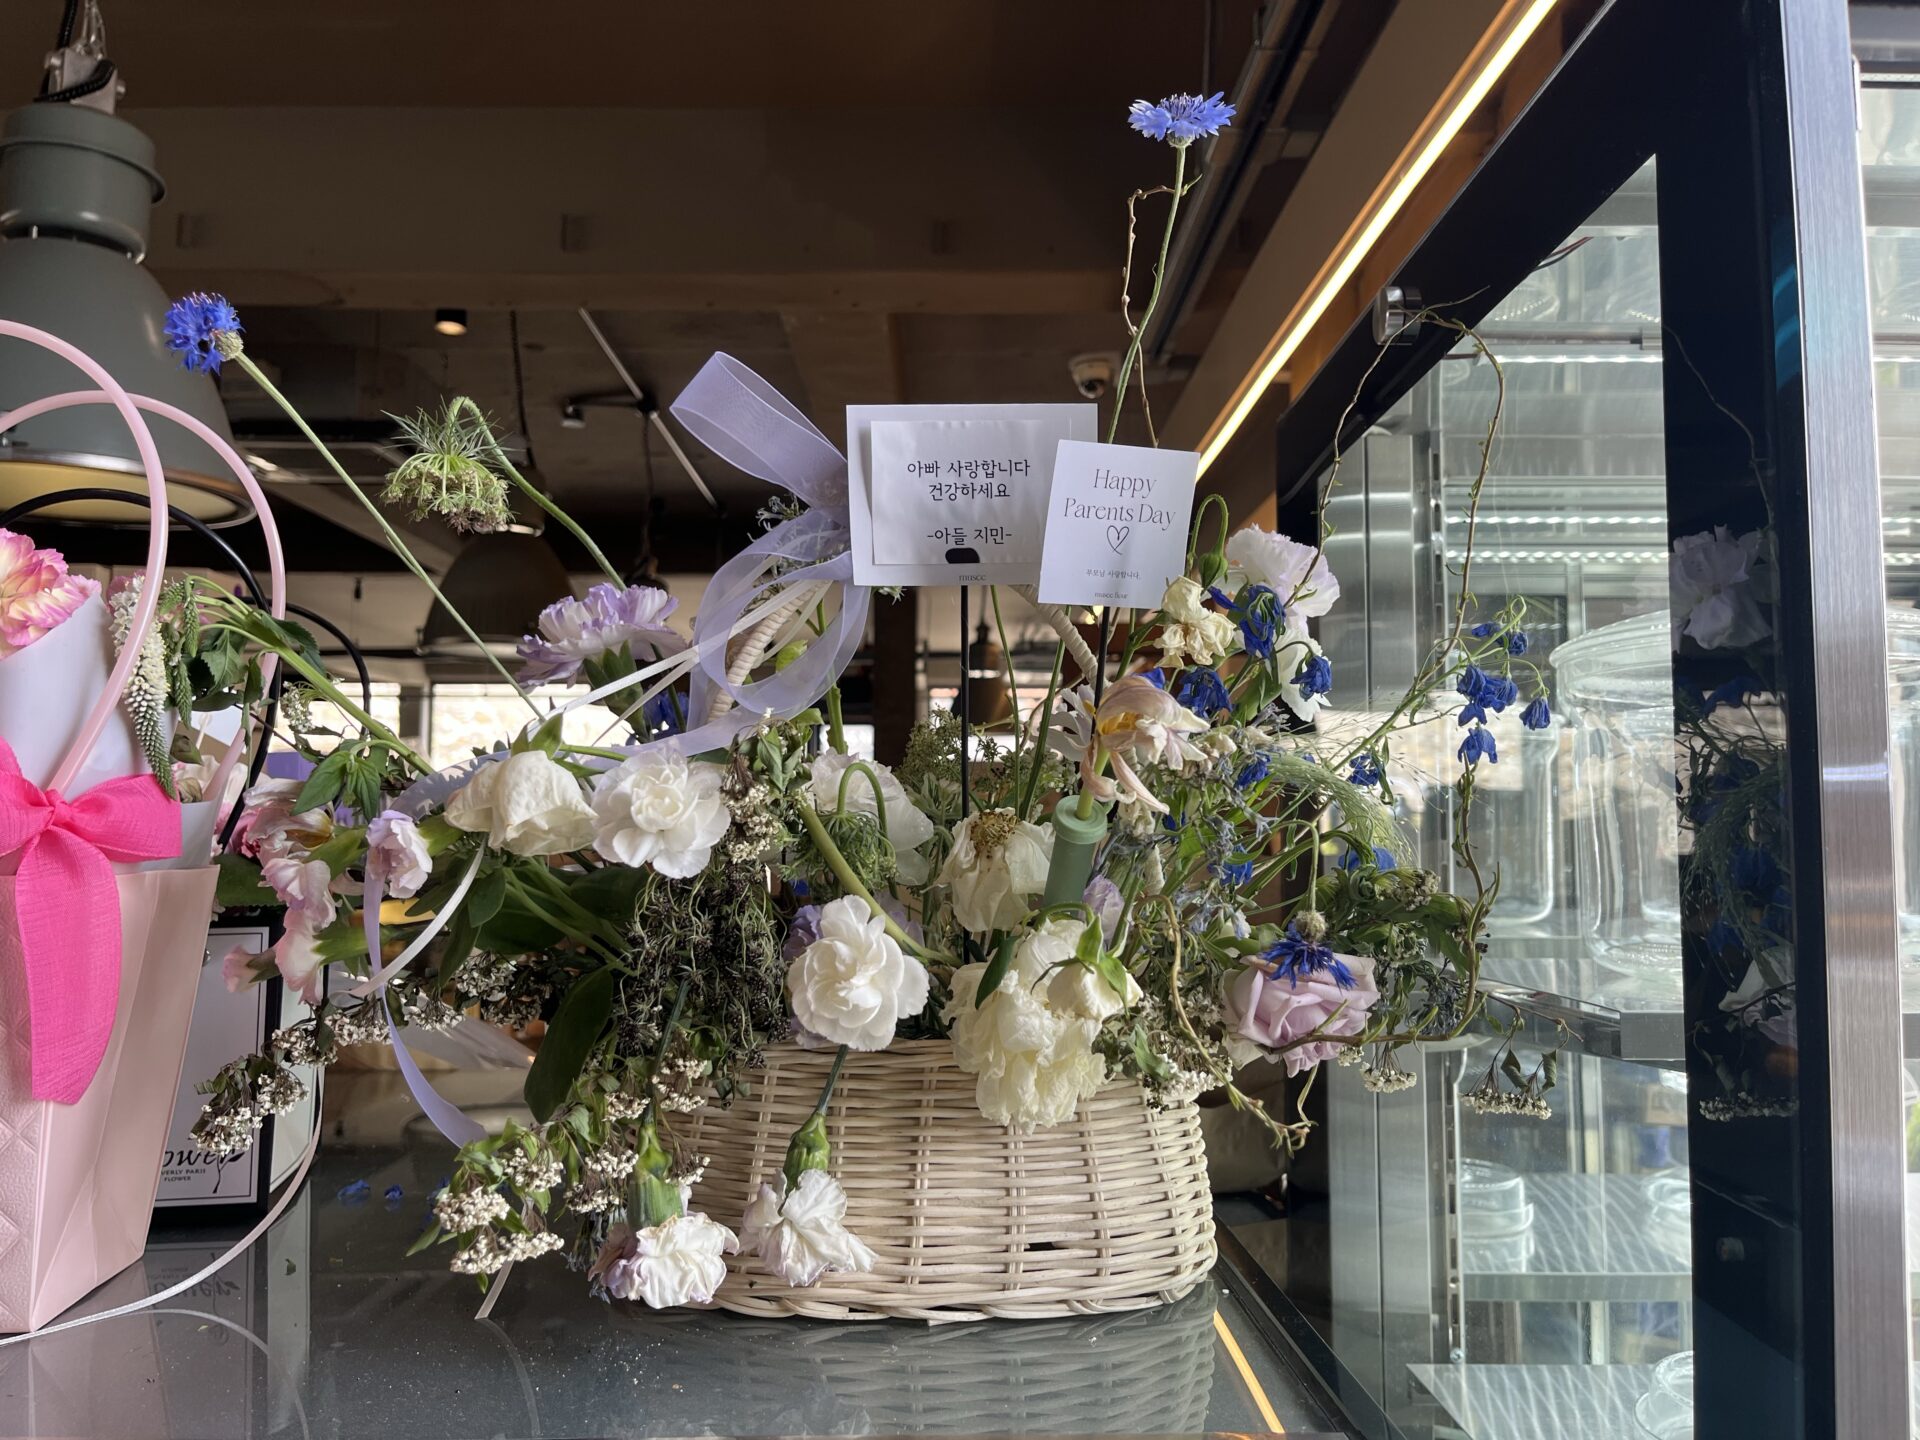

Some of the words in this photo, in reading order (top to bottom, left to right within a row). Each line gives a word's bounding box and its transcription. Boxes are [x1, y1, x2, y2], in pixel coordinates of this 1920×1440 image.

[907, 460, 941, 478] 아빠
[947, 459, 1031, 479] 사랑합니다
[928, 482, 1010, 501] 건강하세요
[1093, 468, 1157, 499] Happy
[1064, 497, 1134, 522] Parents
[1138, 503, 1177, 531] Day
[927, 527, 967, 545] -아들
[974, 526, 1012, 545] 지민-
